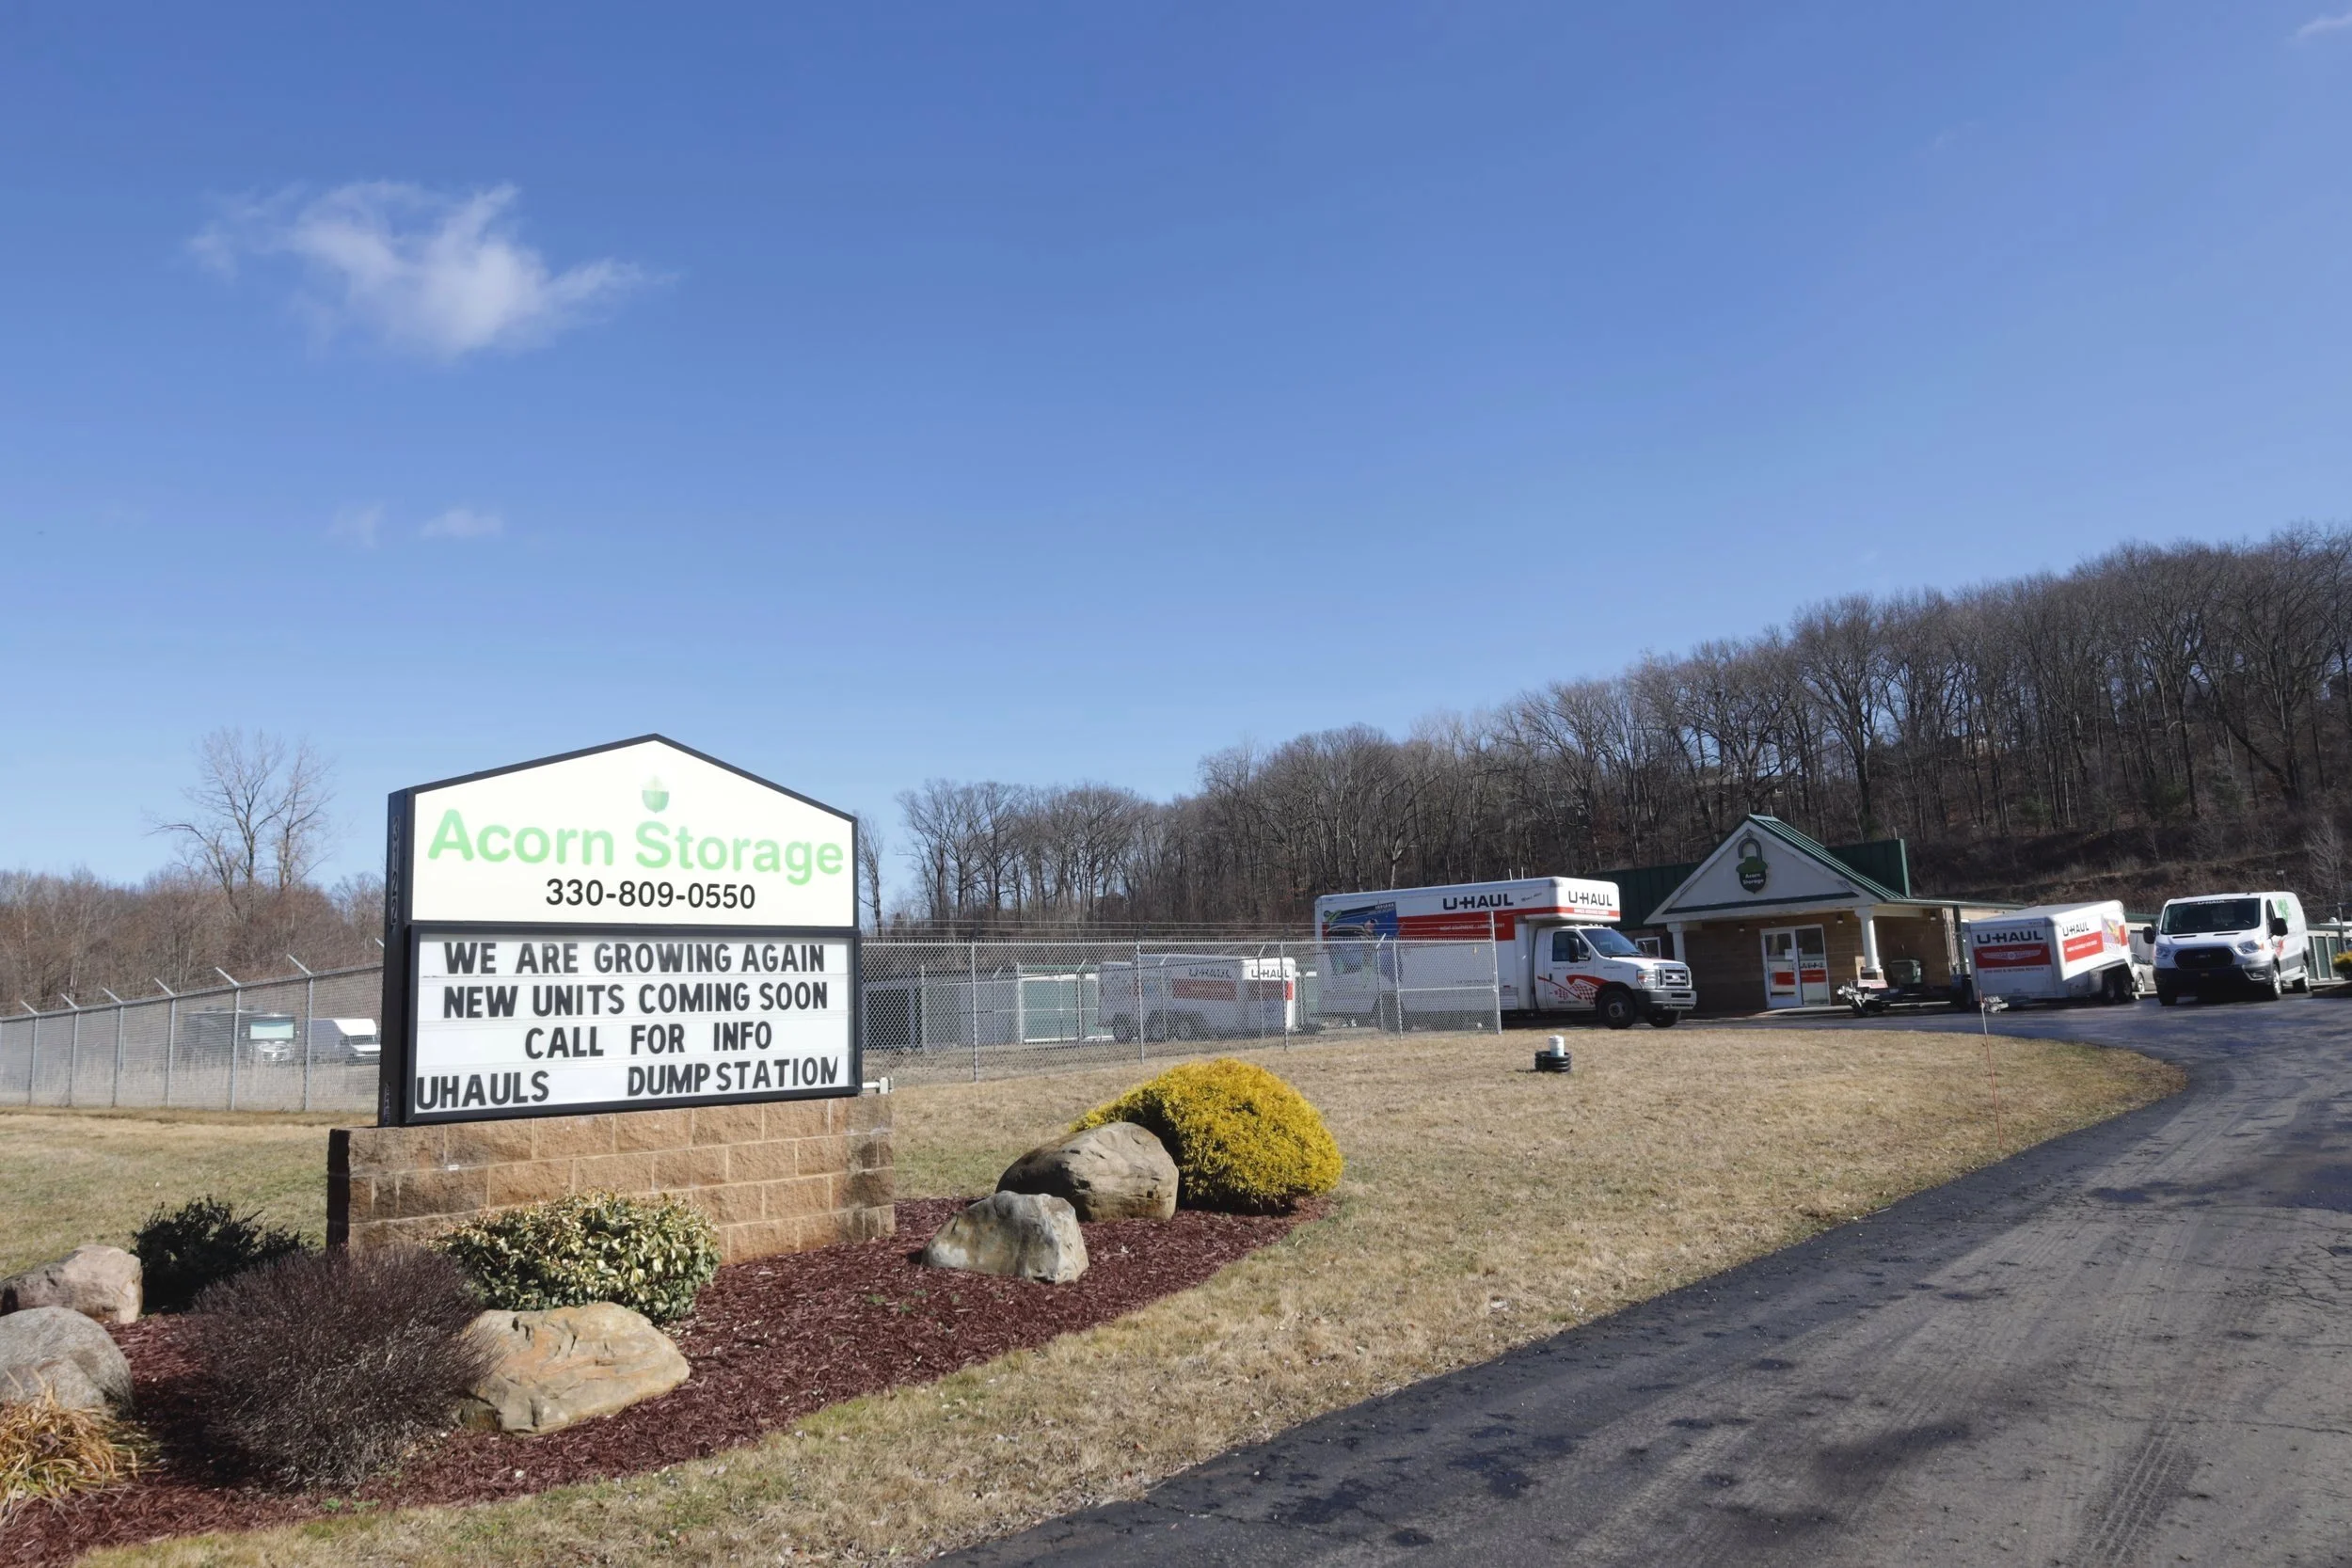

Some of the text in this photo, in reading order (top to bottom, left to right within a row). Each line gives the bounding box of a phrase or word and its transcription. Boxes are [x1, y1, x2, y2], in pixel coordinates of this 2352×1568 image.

[427, 809, 844, 886] Acorn Storage
[547, 878, 755, 910] 330-809-0550
[1442, 893, 1514, 911] U-HAUL
[1568, 891, 1613, 907] U-HAUL
[1977, 930, 2043, 944] U-HAUL
[443, 942, 824, 974] WE ARE GROWING AGAIN
[443, 981, 828, 1019] NEW UNITS COMING SOON
[525, 1021, 772, 1059] CALL FOR INFO
[416, 1070, 549, 1111] UHAULS
